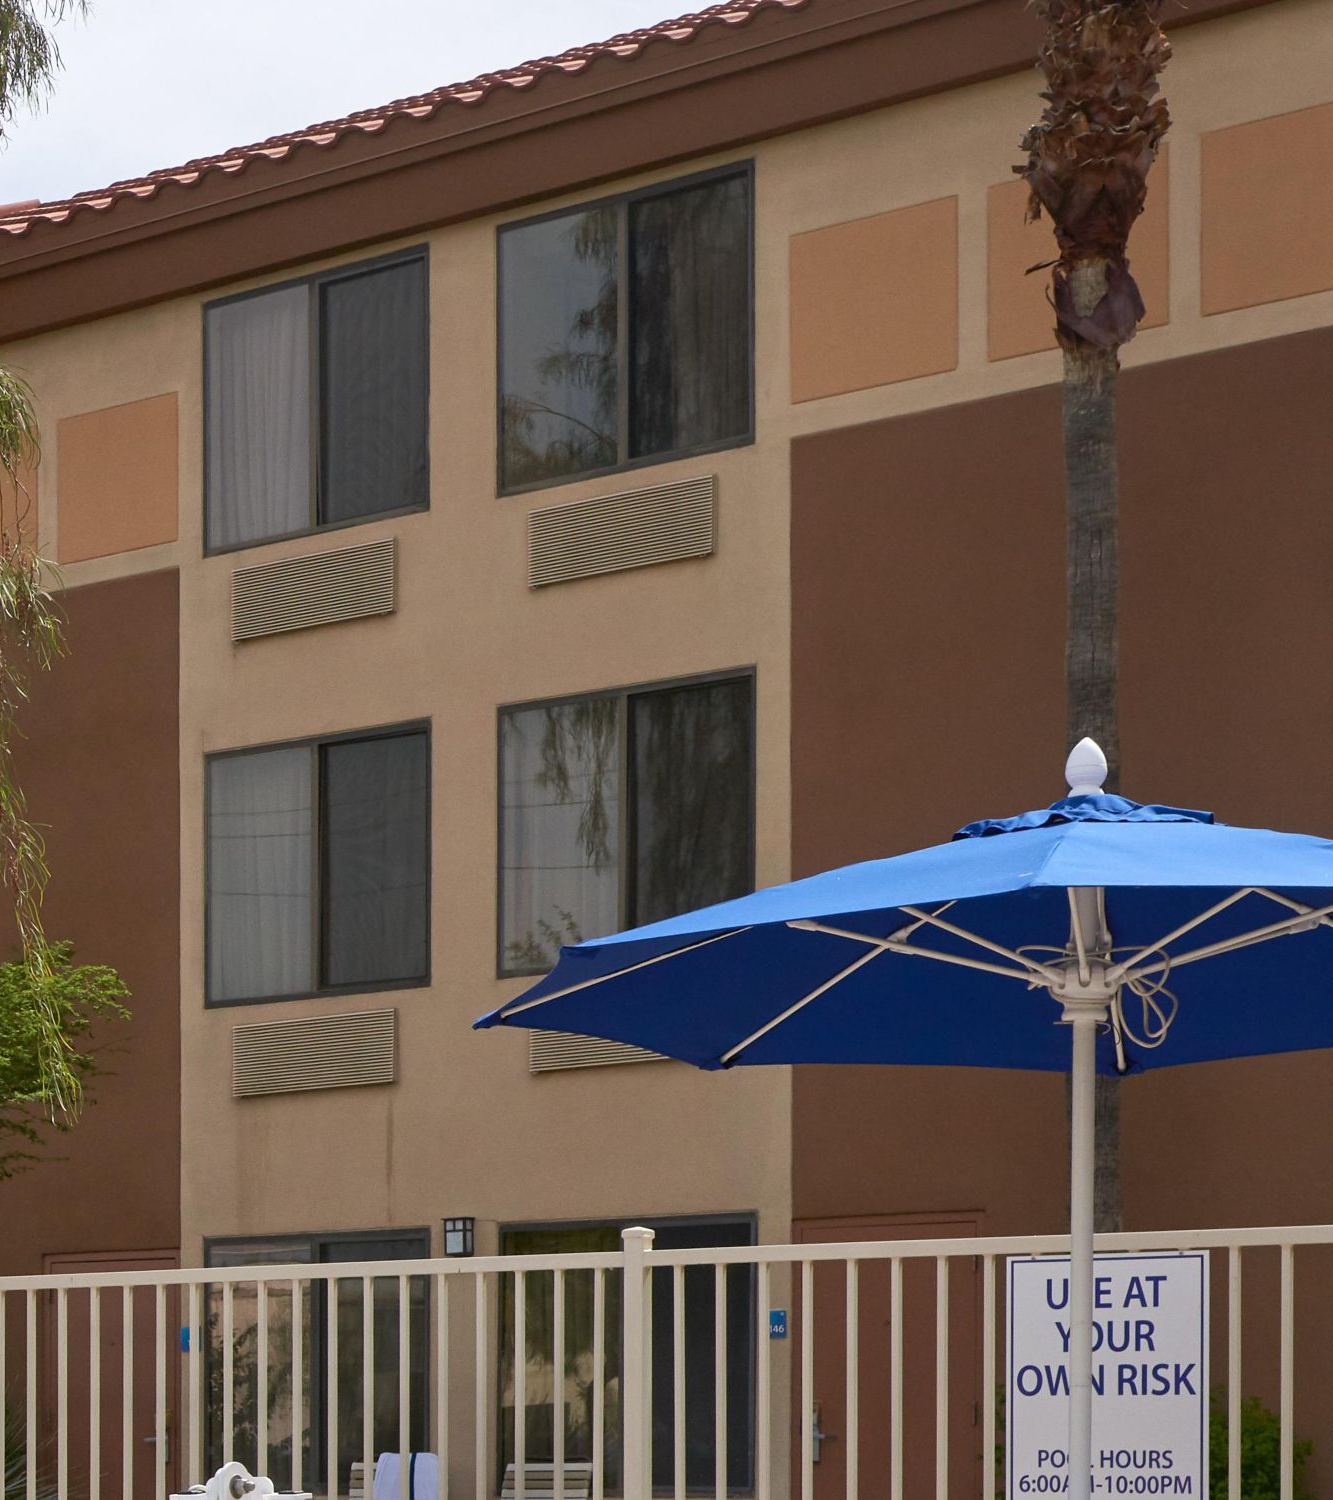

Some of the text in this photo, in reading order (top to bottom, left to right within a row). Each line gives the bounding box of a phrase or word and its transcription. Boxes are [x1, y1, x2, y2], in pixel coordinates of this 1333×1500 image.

[1046, 1275, 1167, 1309] UE AT
[1118, 1363, 1196, 1396] RISK
[1038, 1450, 1174, 1469] PO HOURS
[1019, 1474, 1192, 1494] 6:00-10:00PM
